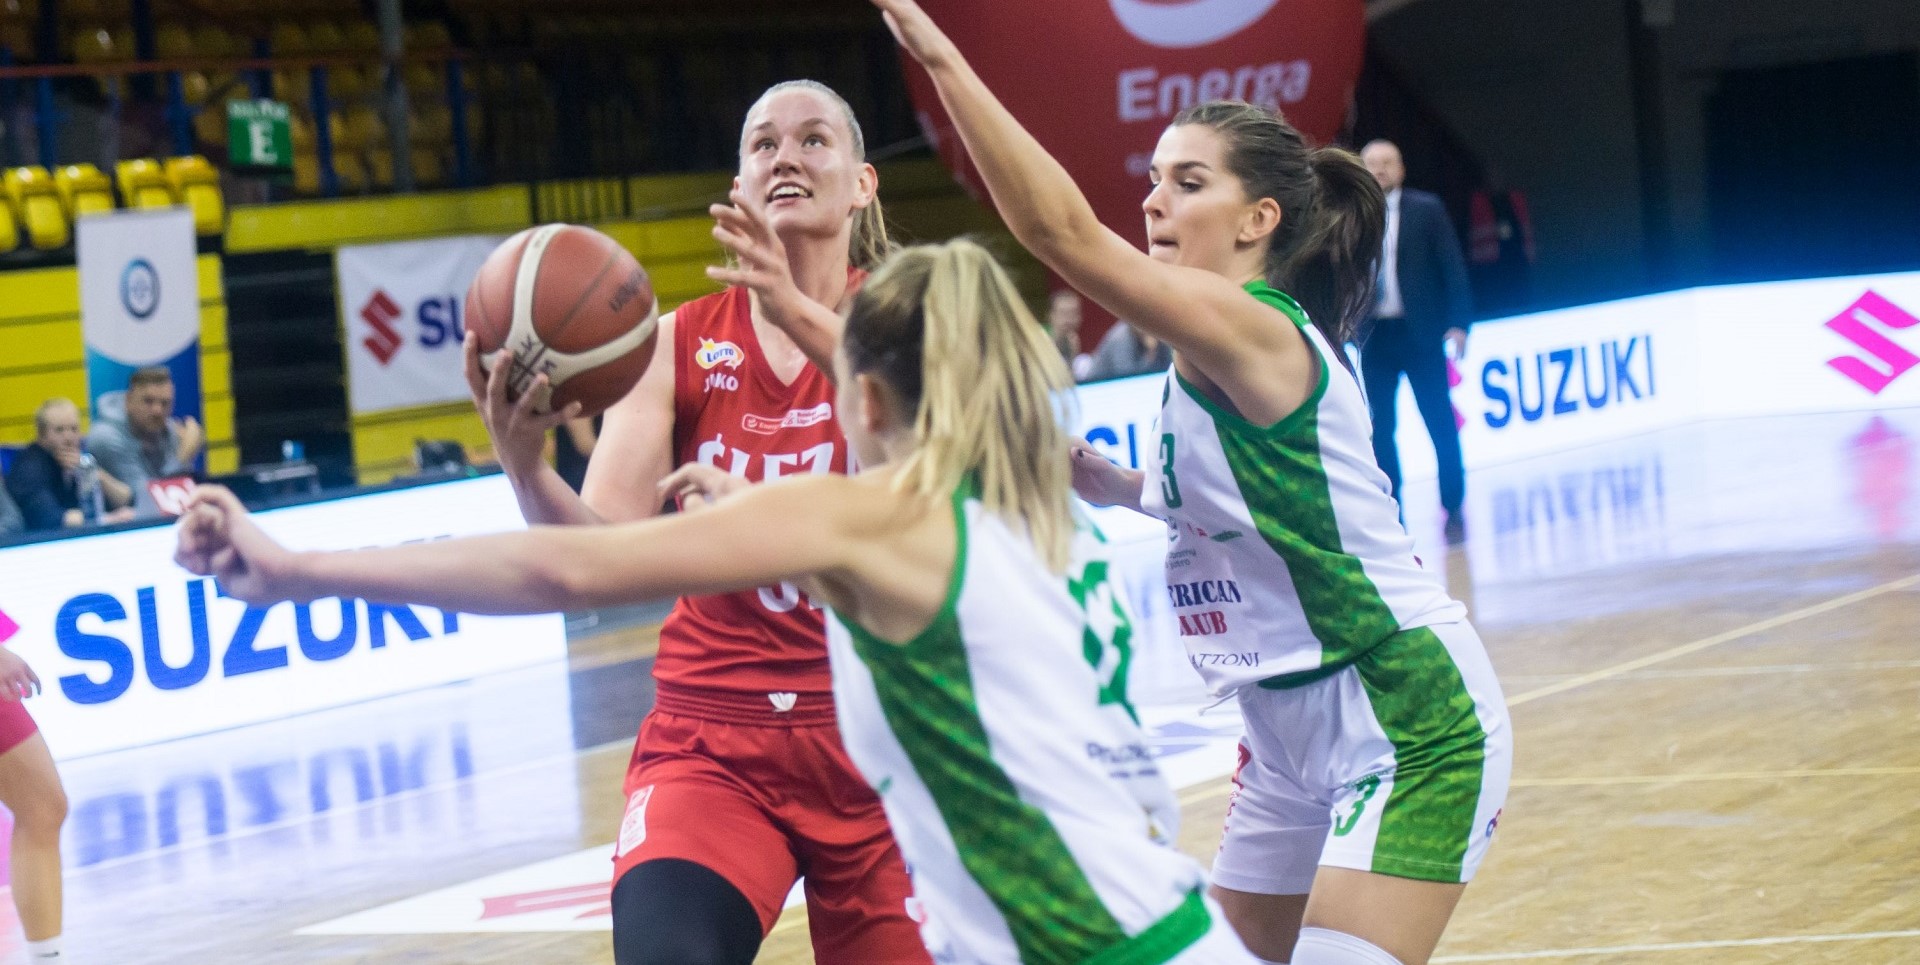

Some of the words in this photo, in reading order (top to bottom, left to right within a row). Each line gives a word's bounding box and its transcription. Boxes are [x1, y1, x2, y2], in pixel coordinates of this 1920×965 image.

[1118, 60, 1312, 121] Energa
[249, 121, 278, 165] E
[1481, 335, 1656, 429] SUZUKI
[1179, 610, 1228, 637] LUB
[1333, 774, 1382, 837] 3
